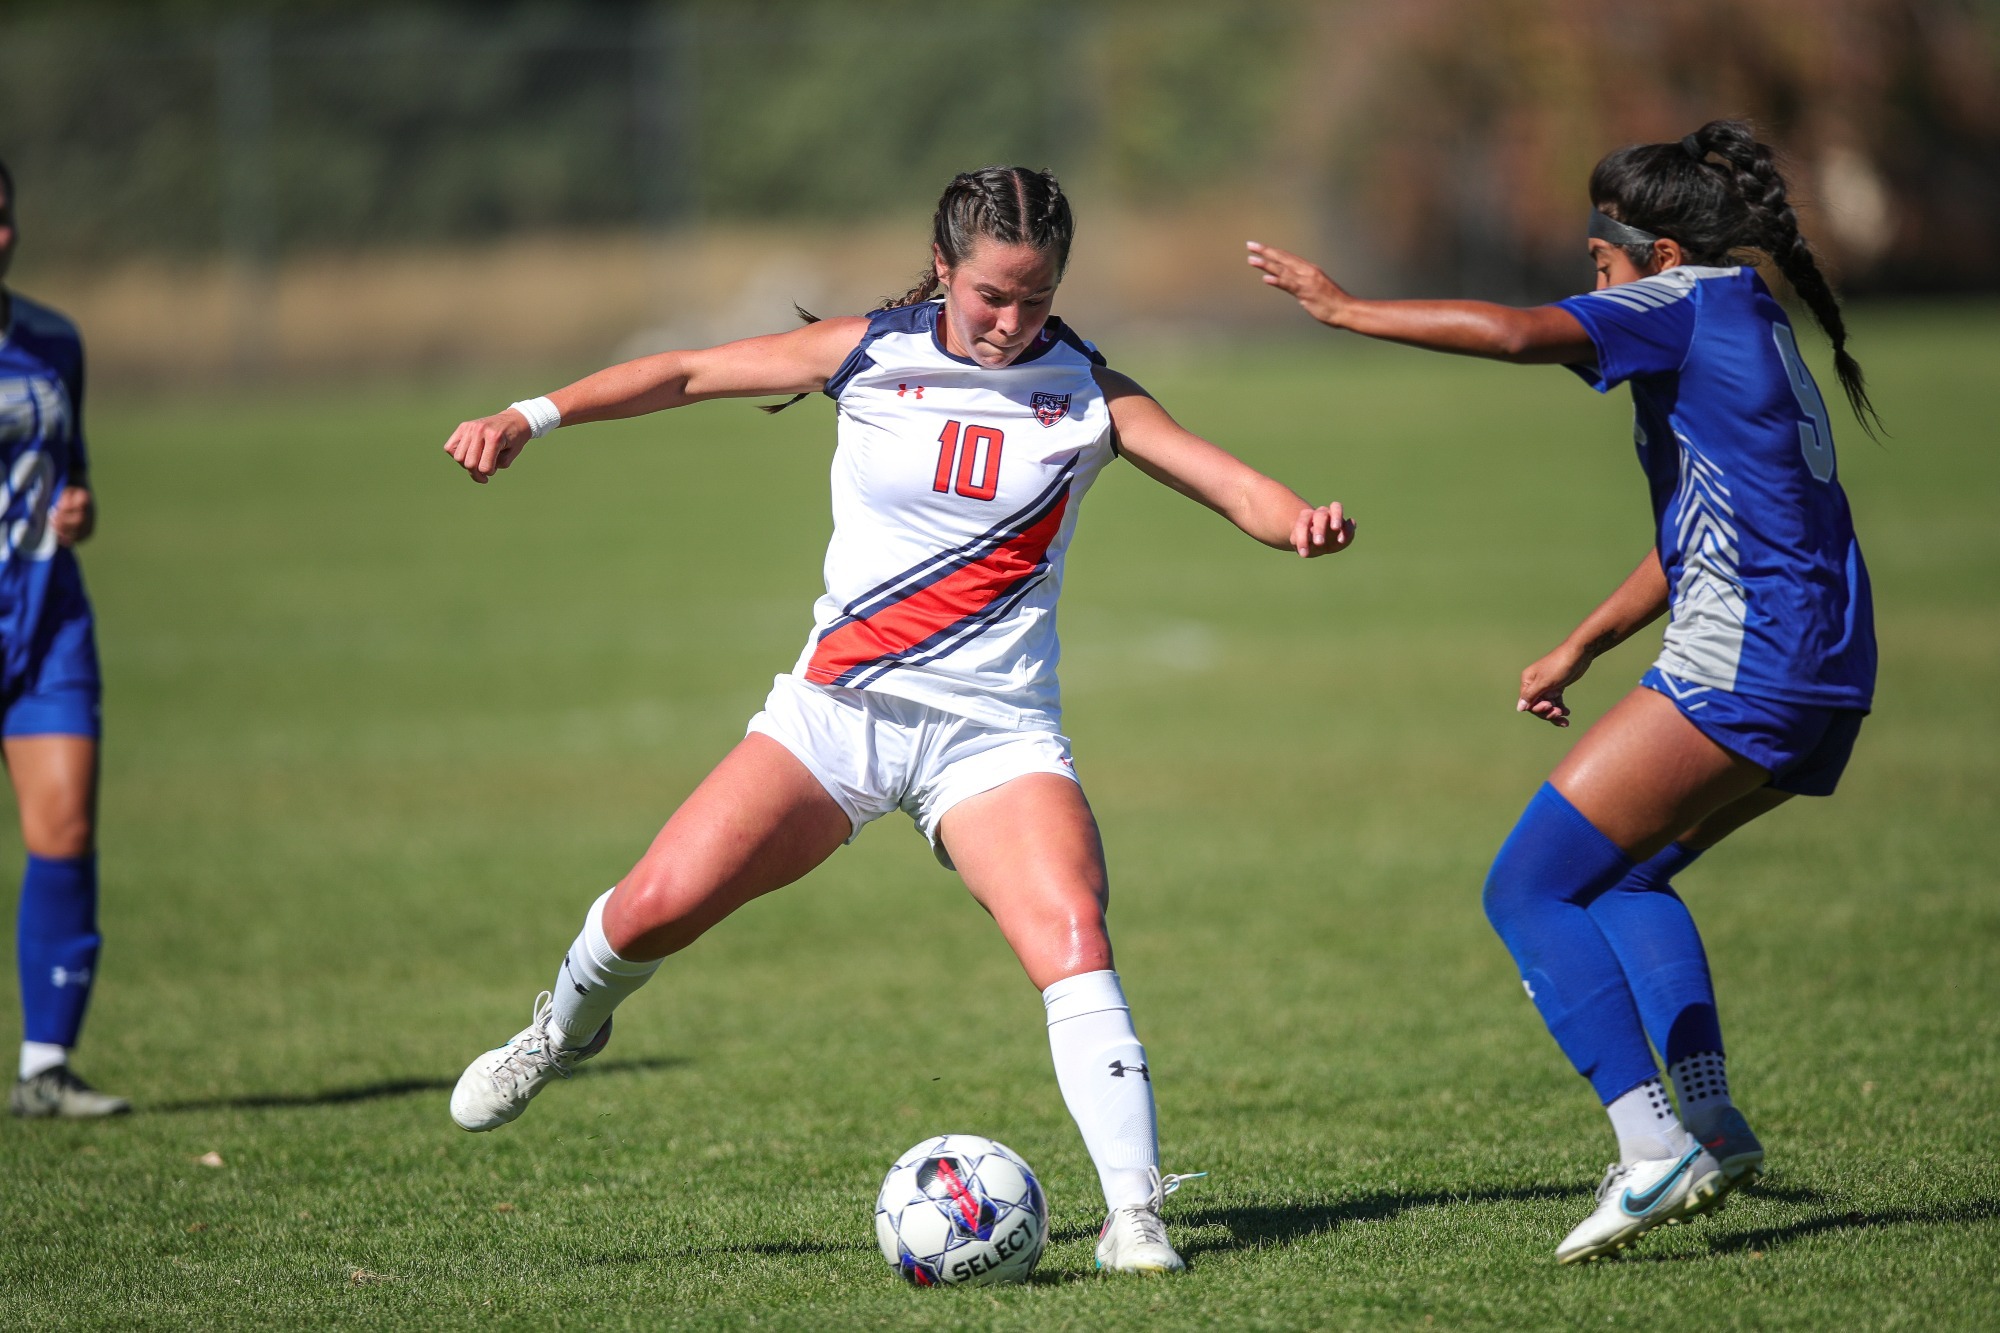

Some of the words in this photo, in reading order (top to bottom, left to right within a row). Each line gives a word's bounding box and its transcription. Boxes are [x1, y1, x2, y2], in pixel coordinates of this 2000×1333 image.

[1773, 321, 1834, 483] 9
[0, 449, 57, 561] 3
[933, 420, 1004, 501] 10
[952, 1218, 1034, 1282] SELECT
